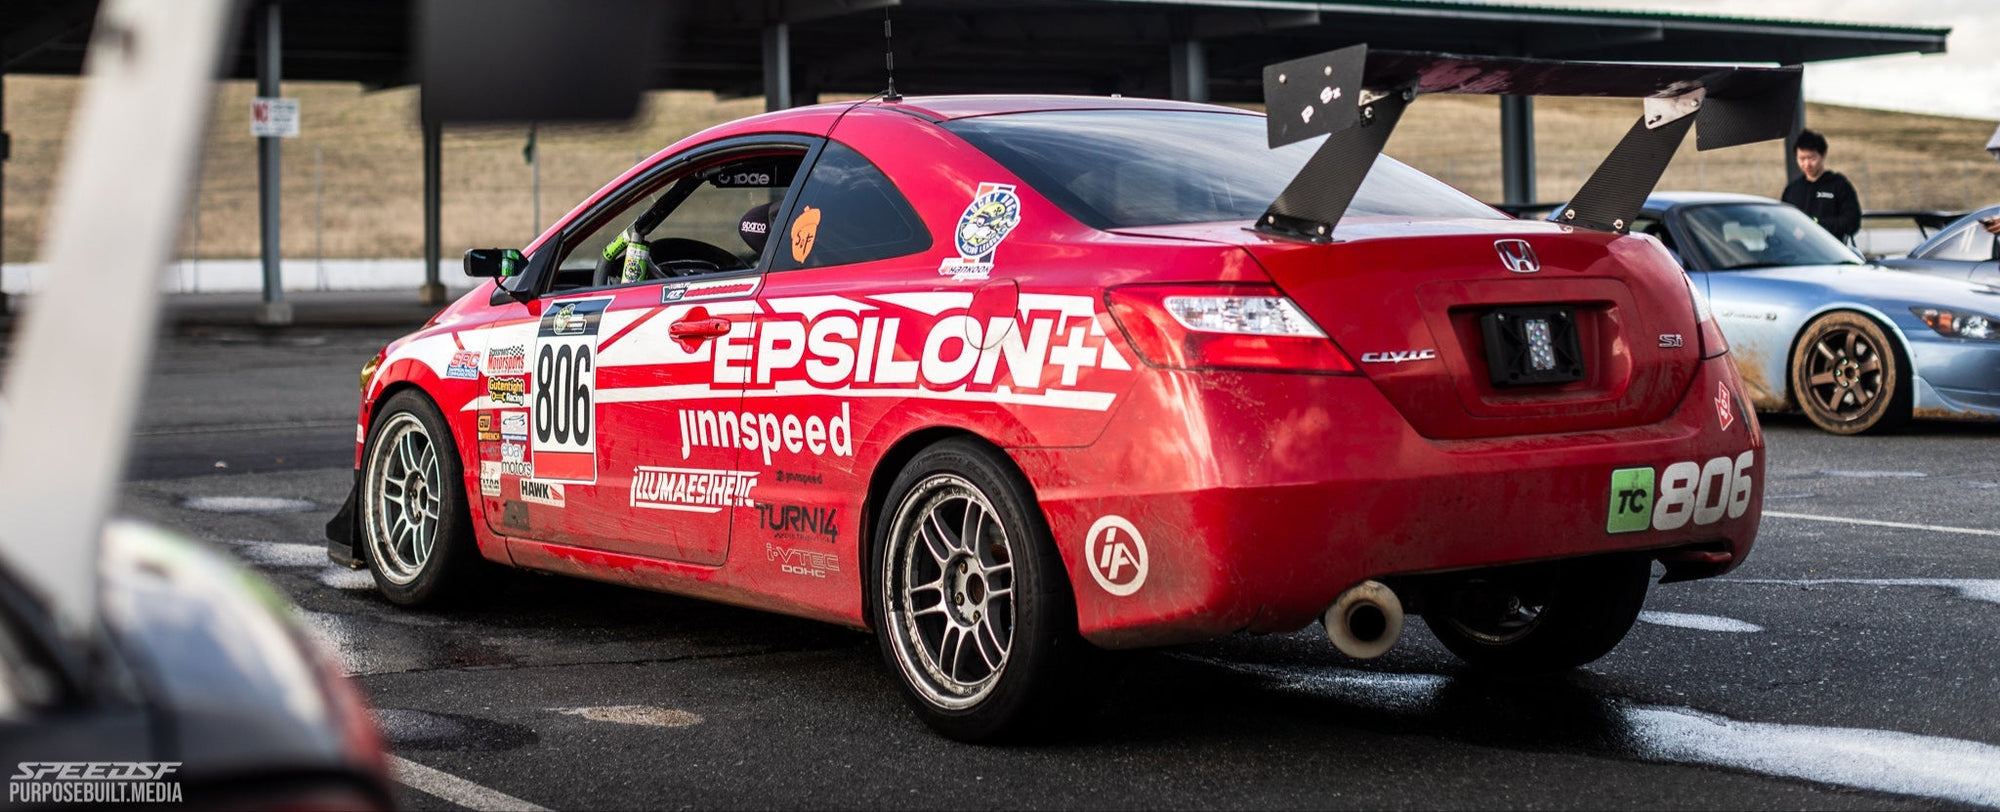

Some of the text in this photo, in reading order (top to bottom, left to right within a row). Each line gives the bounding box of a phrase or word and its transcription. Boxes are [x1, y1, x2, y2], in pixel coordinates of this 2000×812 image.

[741, 221, 766, 234] sparco
[1659, 334, 1683, 348] Si
[714, 315, 1098, 387] EPSILON+
[1361, 348, 1436, 364] CIVIC
[487, 355, 525, 372] Motorsports
[536, 344, 591, 446] 806
[501, 461, 532, 476] motors
[521, 480, 550, 500] HAWK
[1652, 450, 1754, 531] 806
[1618, 489, 1647, 514] TC
[755, 502, 838, 544] TURN14
[781, 564, 826, 578] DOHC
